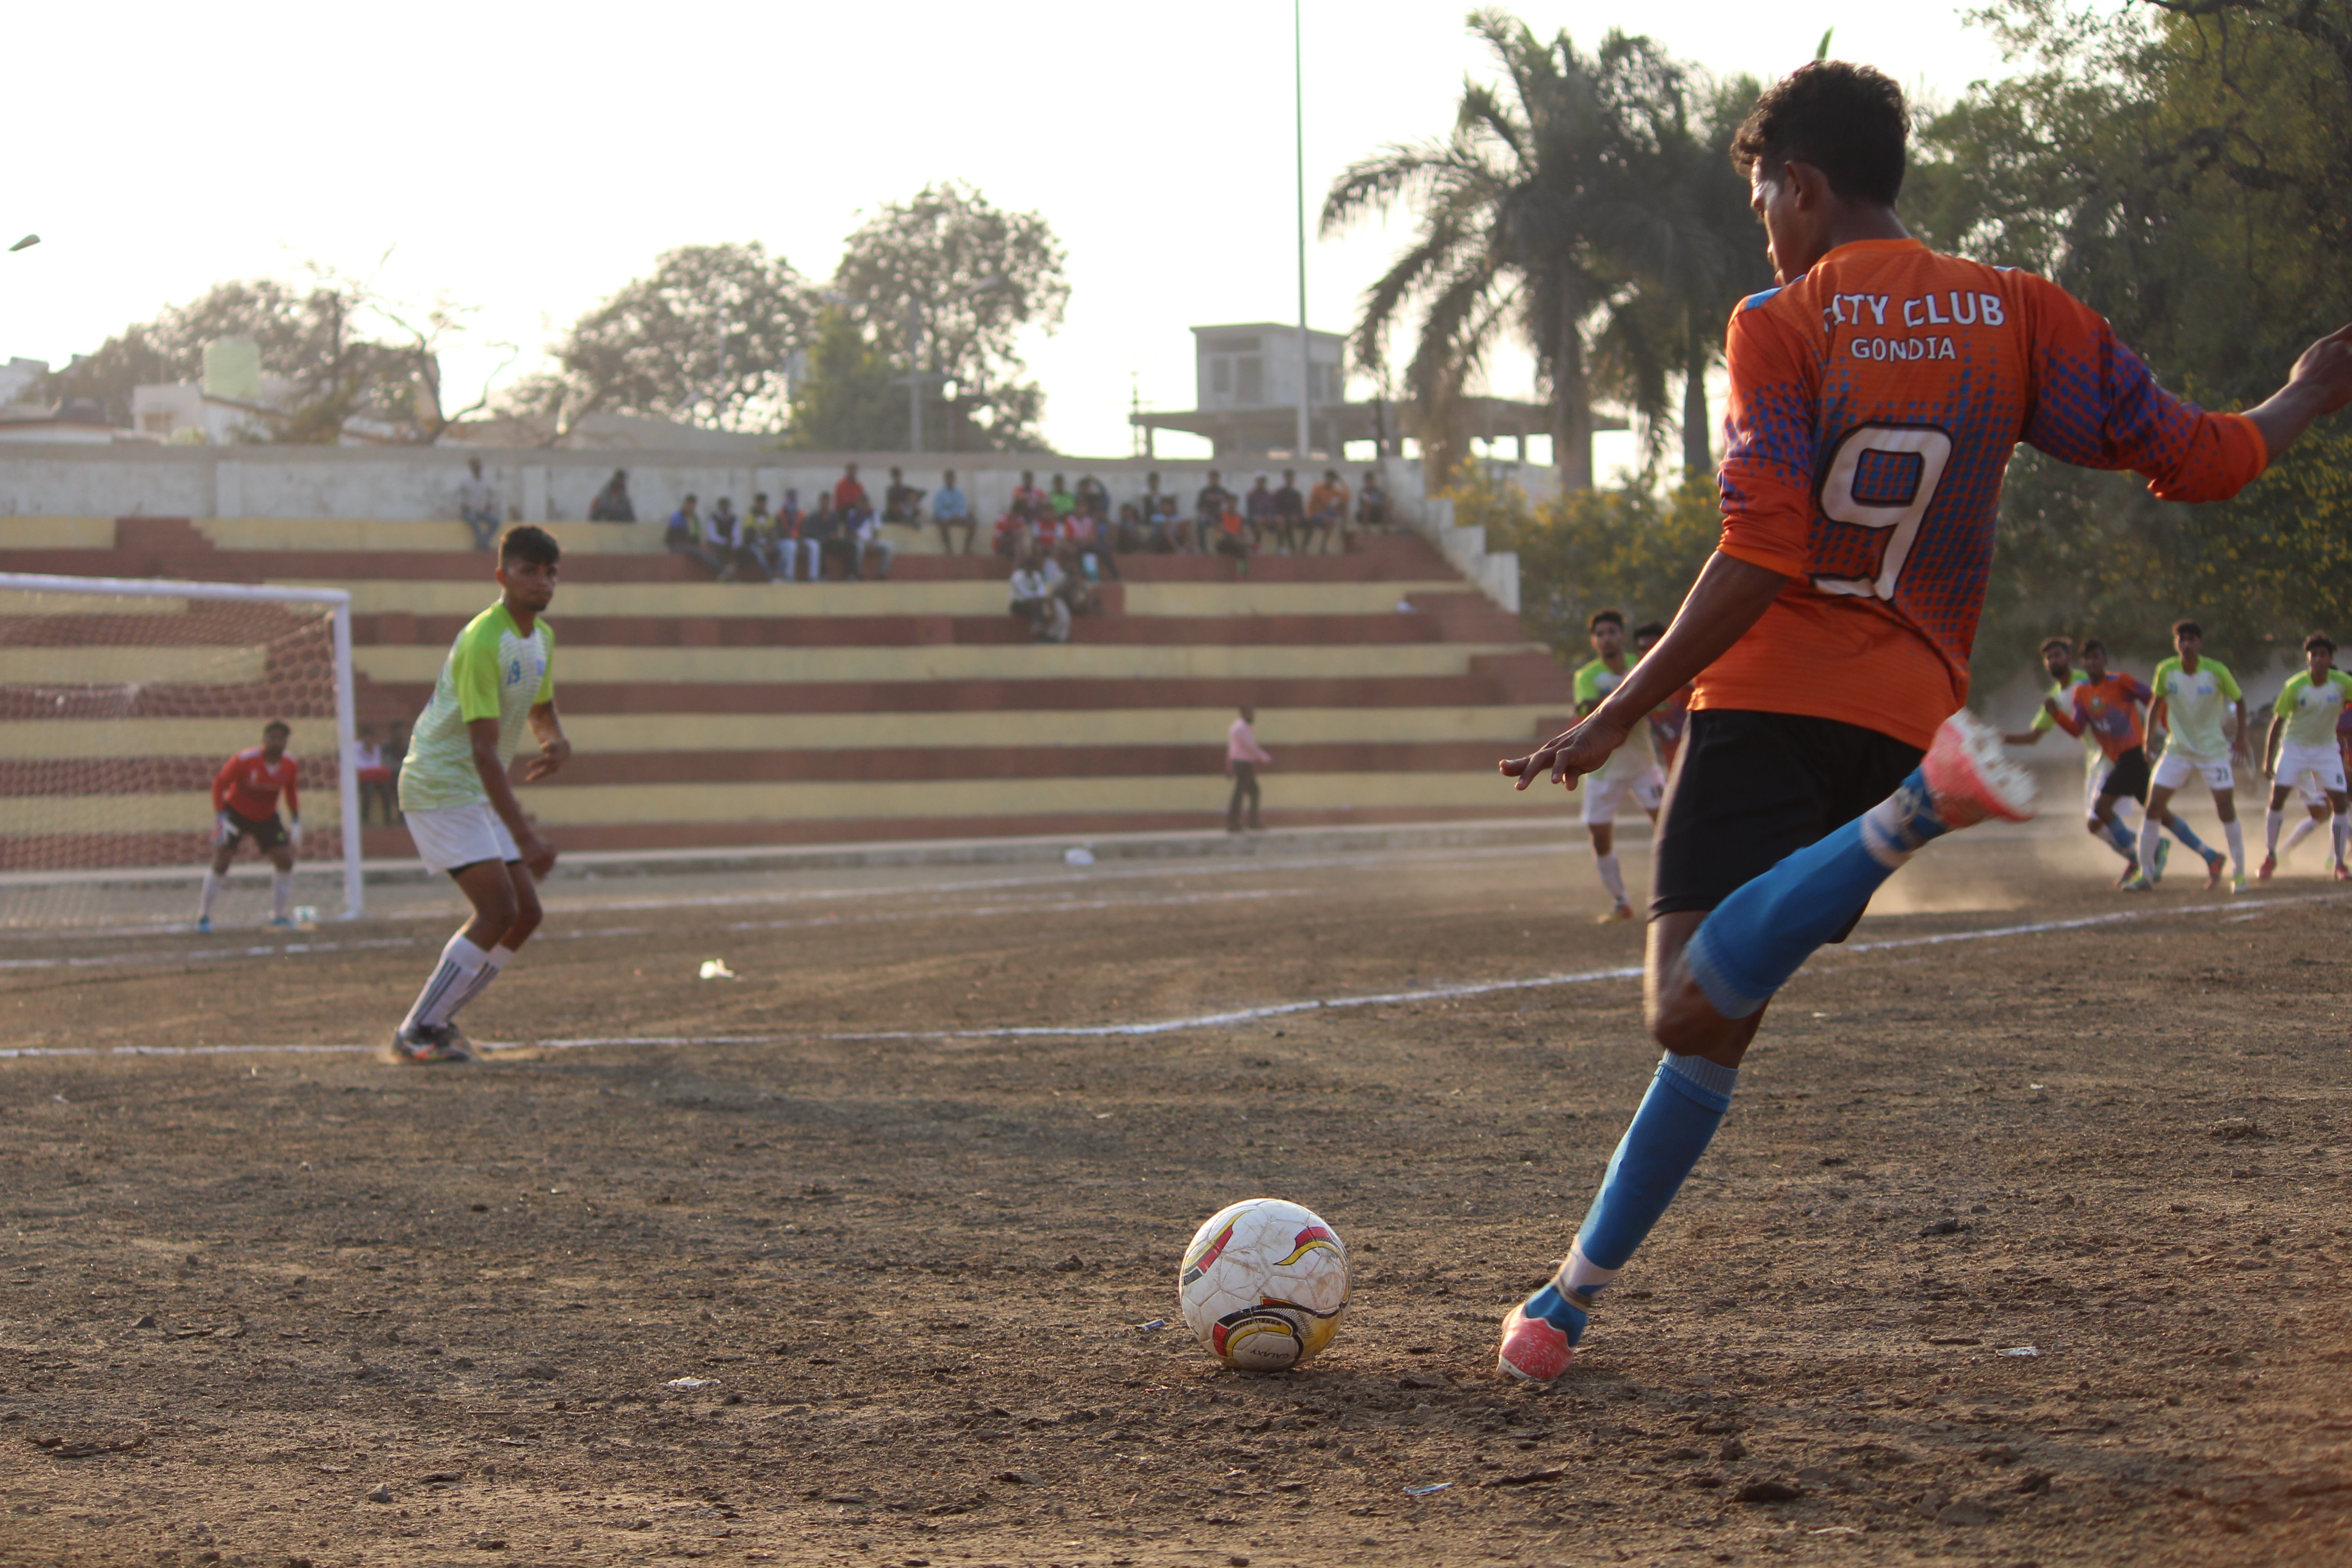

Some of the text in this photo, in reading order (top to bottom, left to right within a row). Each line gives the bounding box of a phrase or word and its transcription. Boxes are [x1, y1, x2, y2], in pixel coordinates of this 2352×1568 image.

[1903, 291, 2005, 328] CLUB
[1851, 337, 1957, 362] GONDIA
[1813, 425, 1953, 602] 9
[1250, 1349, 1289, 1359] GALAXY
